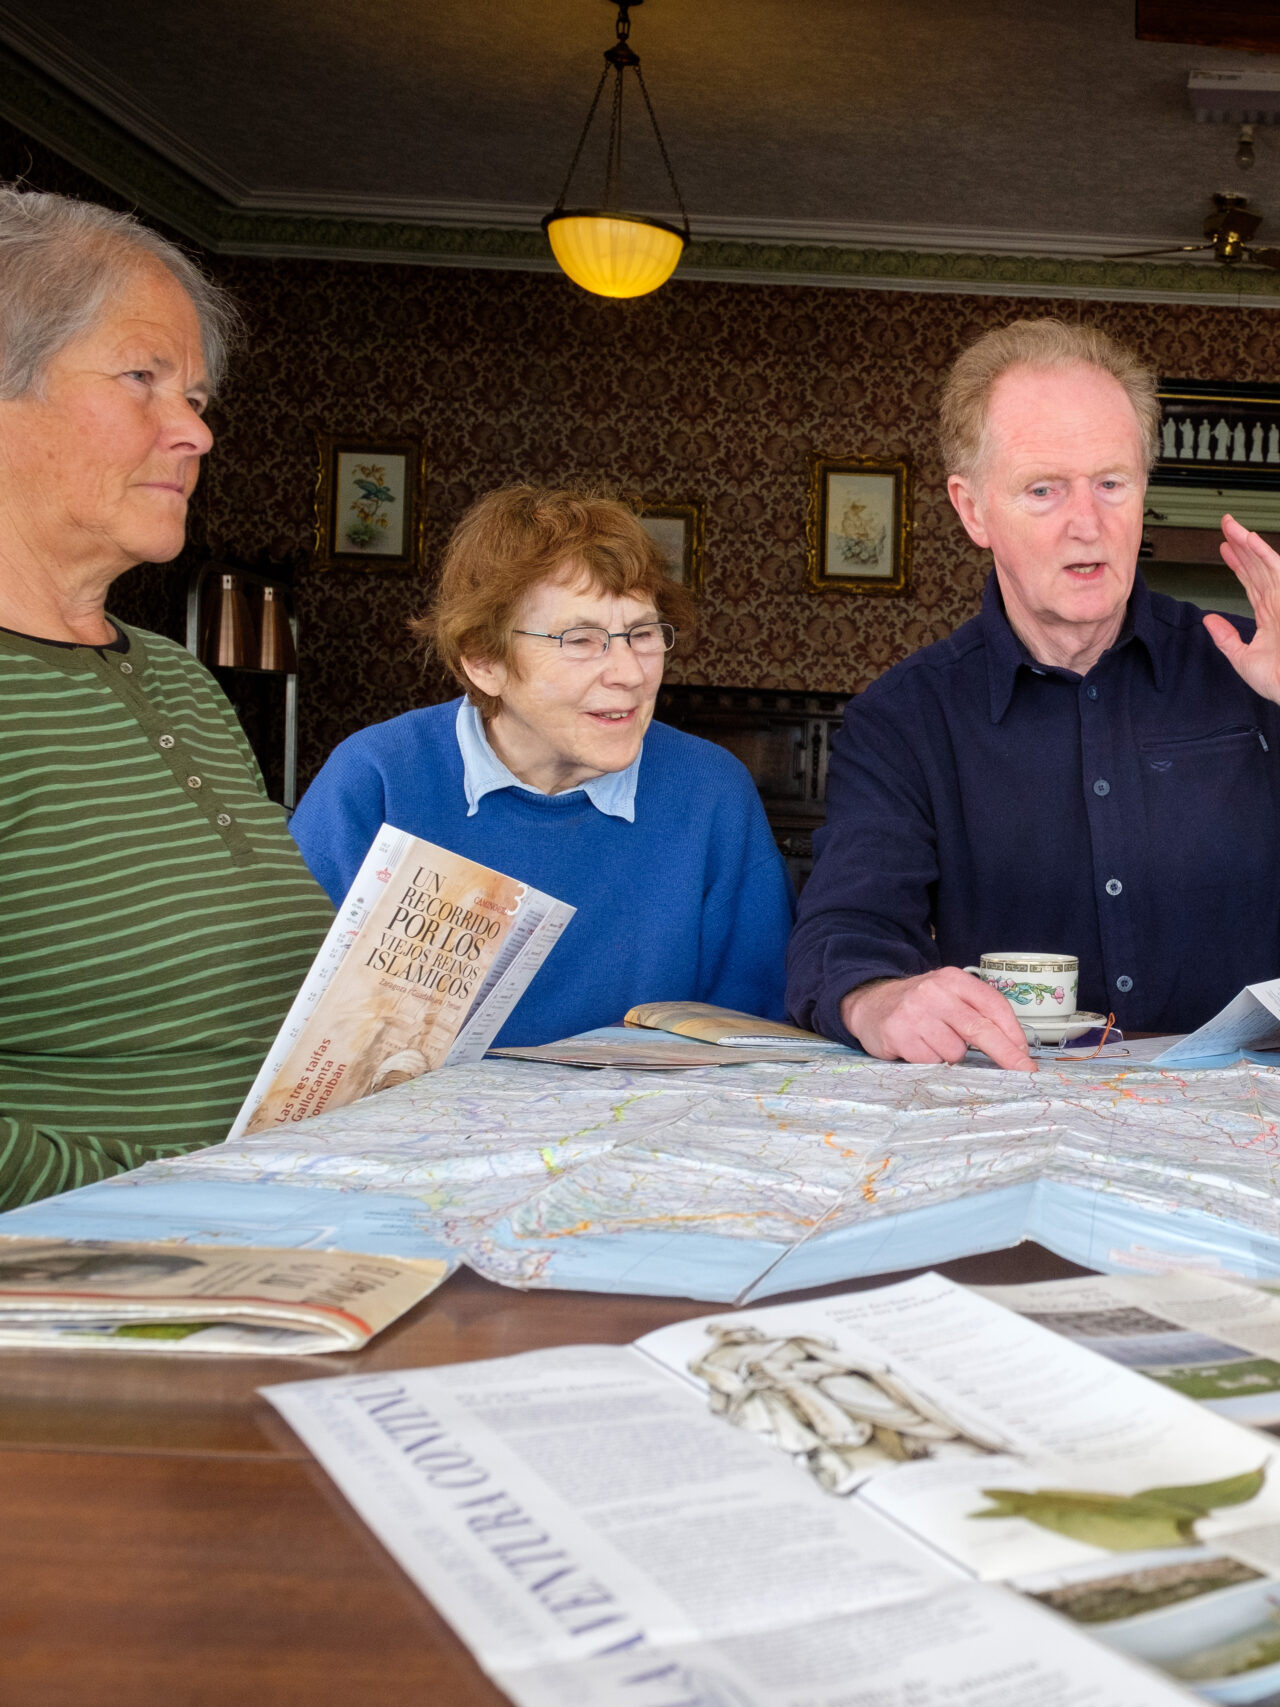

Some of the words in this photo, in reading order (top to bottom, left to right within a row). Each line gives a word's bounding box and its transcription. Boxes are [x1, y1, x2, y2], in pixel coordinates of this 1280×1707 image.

[412, 866, 447, 894] UN
[385, 905, 440, 946] POR
[439, 925, 486, 961] LOS
[400, 886, 501, 939] RECORRIDO
[380, 932, 432, 964] VIEJOS
[432, 952, 481, 981] REINOS
[275, 1102, 294, 1123] Las
[289, 1075, 310, 1099] tres
[305, 1038, 331, 1073] taifas
[291, 1060, 334, 1122] Gallocanta
[307, 1063, 347, 1118] ontalbán
